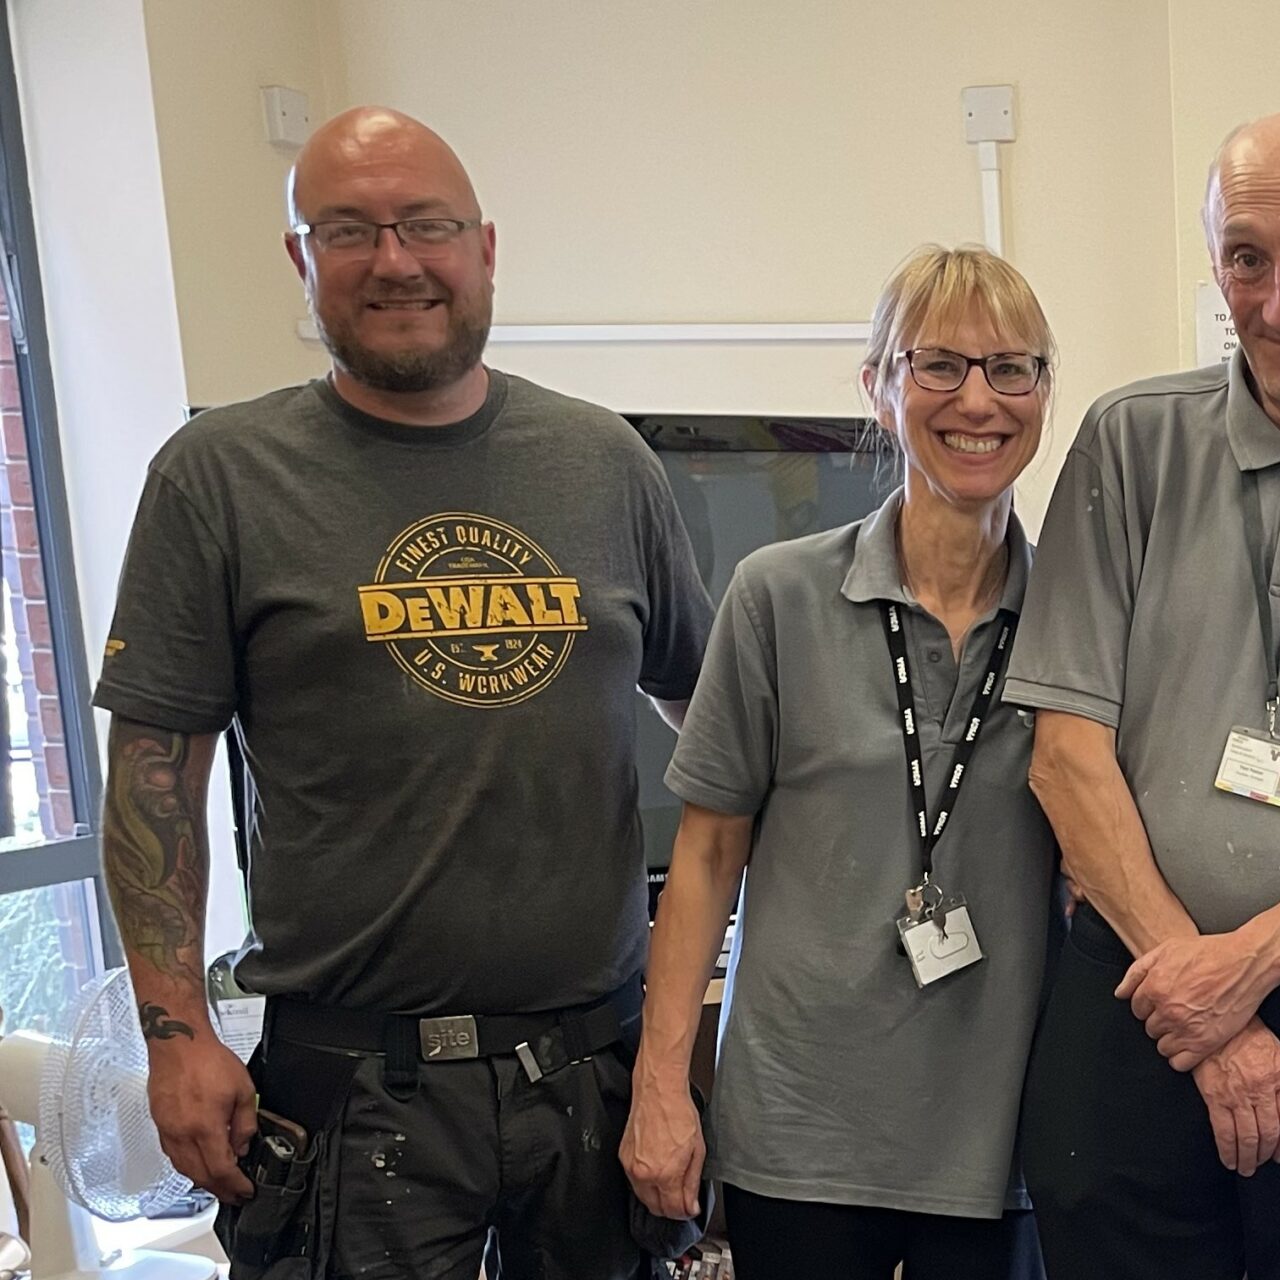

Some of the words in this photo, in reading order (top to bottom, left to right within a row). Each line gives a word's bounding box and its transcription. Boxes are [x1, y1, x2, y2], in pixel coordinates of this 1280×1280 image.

[1214, 313, 1227, 322] TO
[395, 526, 449, 573] FINEST
[456, 525, 534, 566] QUALITY
[965, 716, 981, 742] YMCA
[949, 763, 965, 788] YMCA
[427, 1028, 471, 1049] site
